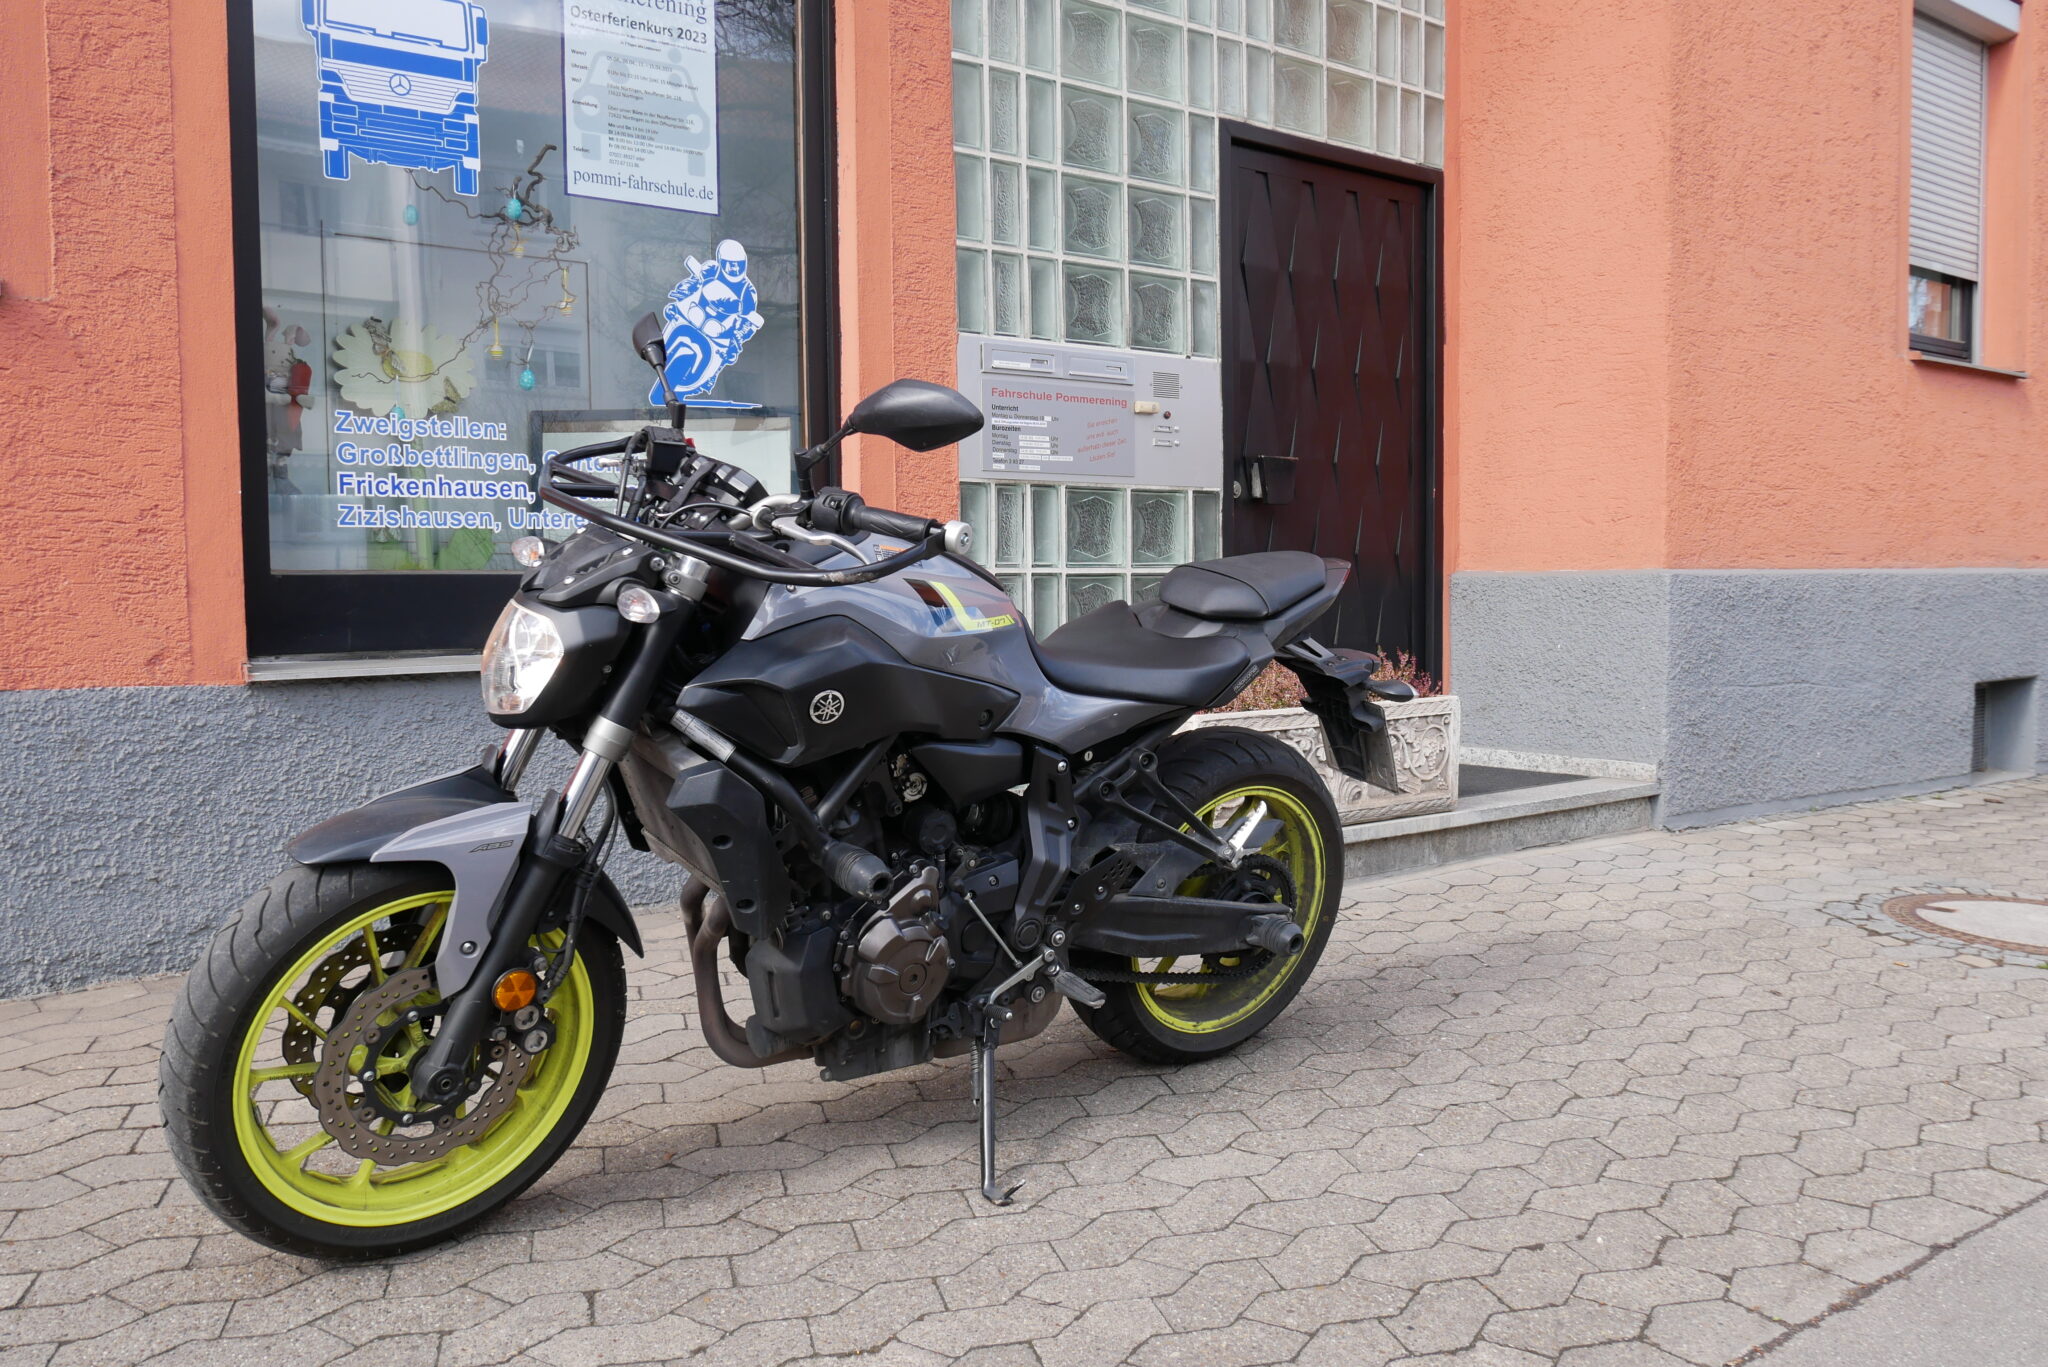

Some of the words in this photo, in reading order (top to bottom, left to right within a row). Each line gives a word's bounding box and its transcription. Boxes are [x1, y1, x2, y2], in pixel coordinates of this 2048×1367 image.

[570, 5, 673, 38] Osterferienkurs
[677, 27, 708, 44] 2023
[573, 169, 714, 200] pommi-fahrschule.de
[992, 388, 1052, 400] Fahrschule
[1056, 392, 1128, 408] Pommerening
[334, 410, 508, 441] Zweigstellen:
[336, 442, 538, 474] Großbettlingen,
[337, 472, 537, 504] Frickenhausen,
[338, 504, 502, 532] Zizishausen,
[977, 618, 1006, 627] MT-07
[468, 840, 514, 853] ABS
